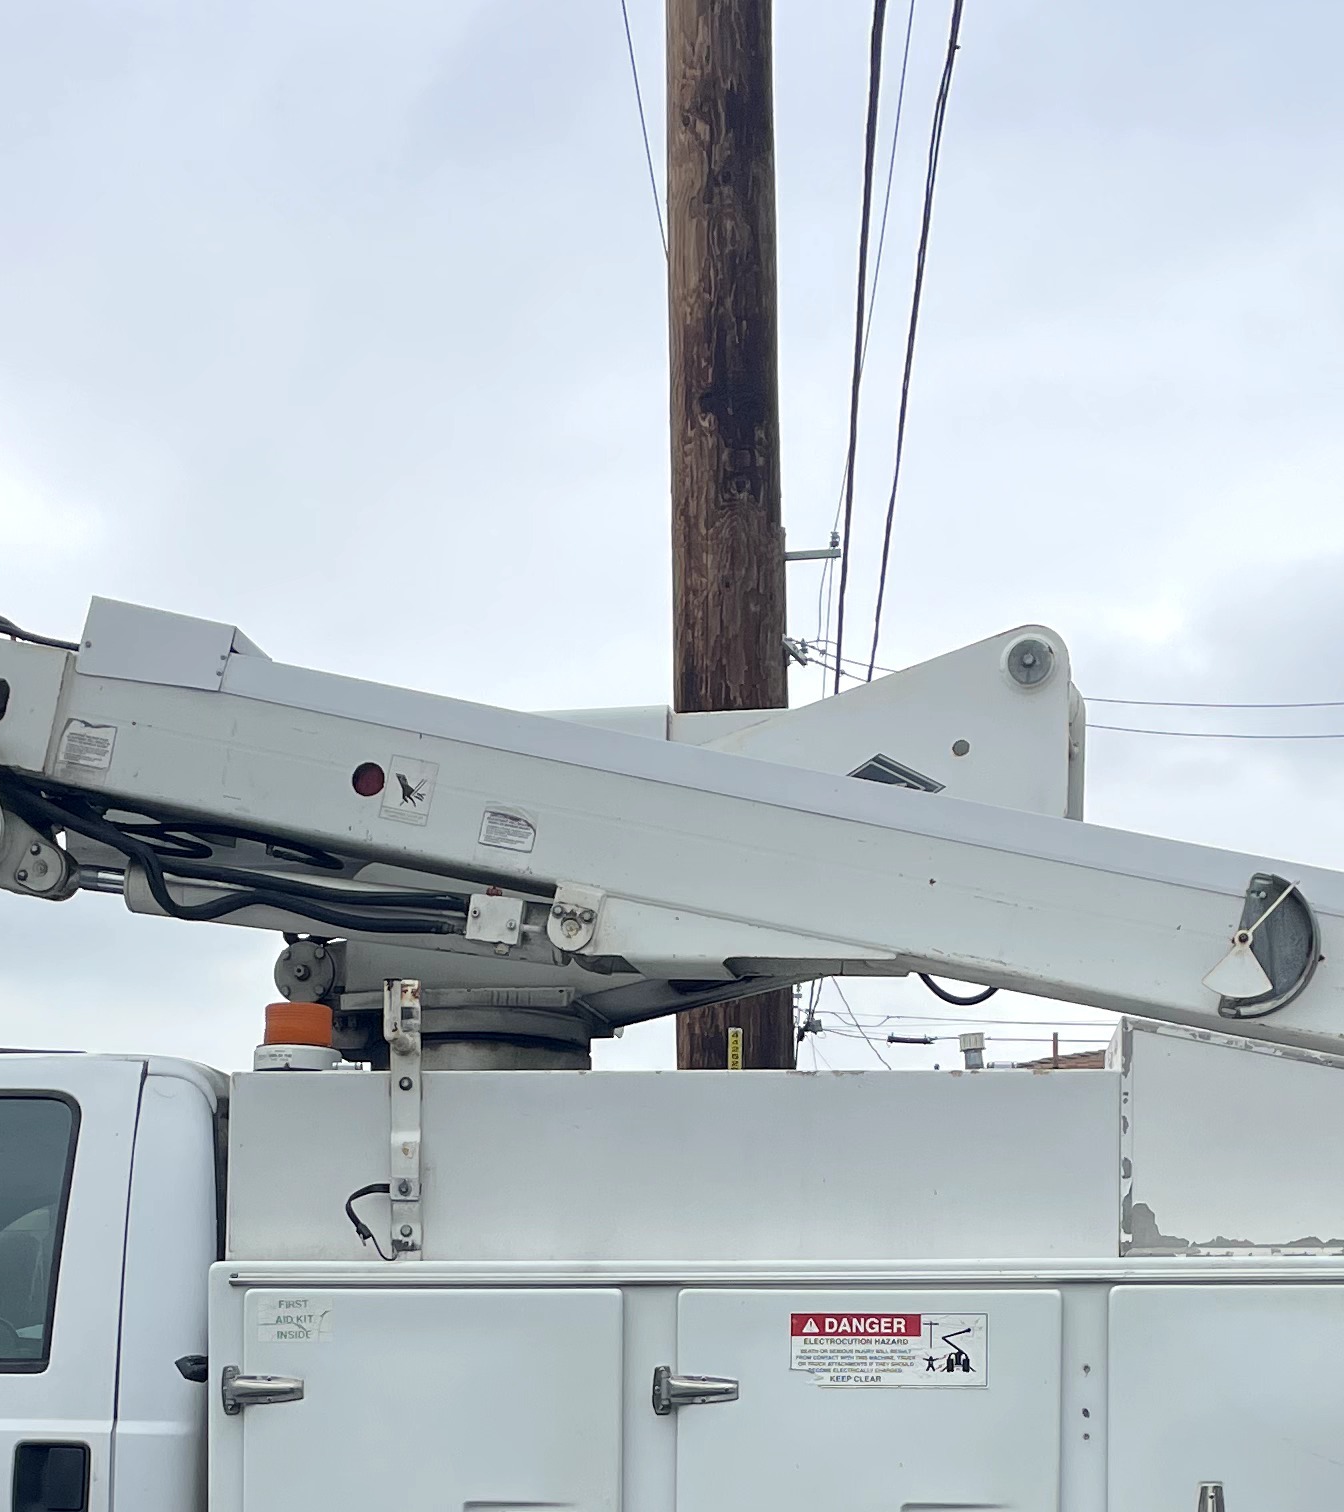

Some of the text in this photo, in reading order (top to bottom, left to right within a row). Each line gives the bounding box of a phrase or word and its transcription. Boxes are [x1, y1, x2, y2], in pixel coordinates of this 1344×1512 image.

[278, 1299, 309, 1309] FIRST
[275, 1314, 314, 1324] AID KIT
[824, 1317, 906, 1333] DANGER
[276, 1330, 312, 1339] INSIDE
